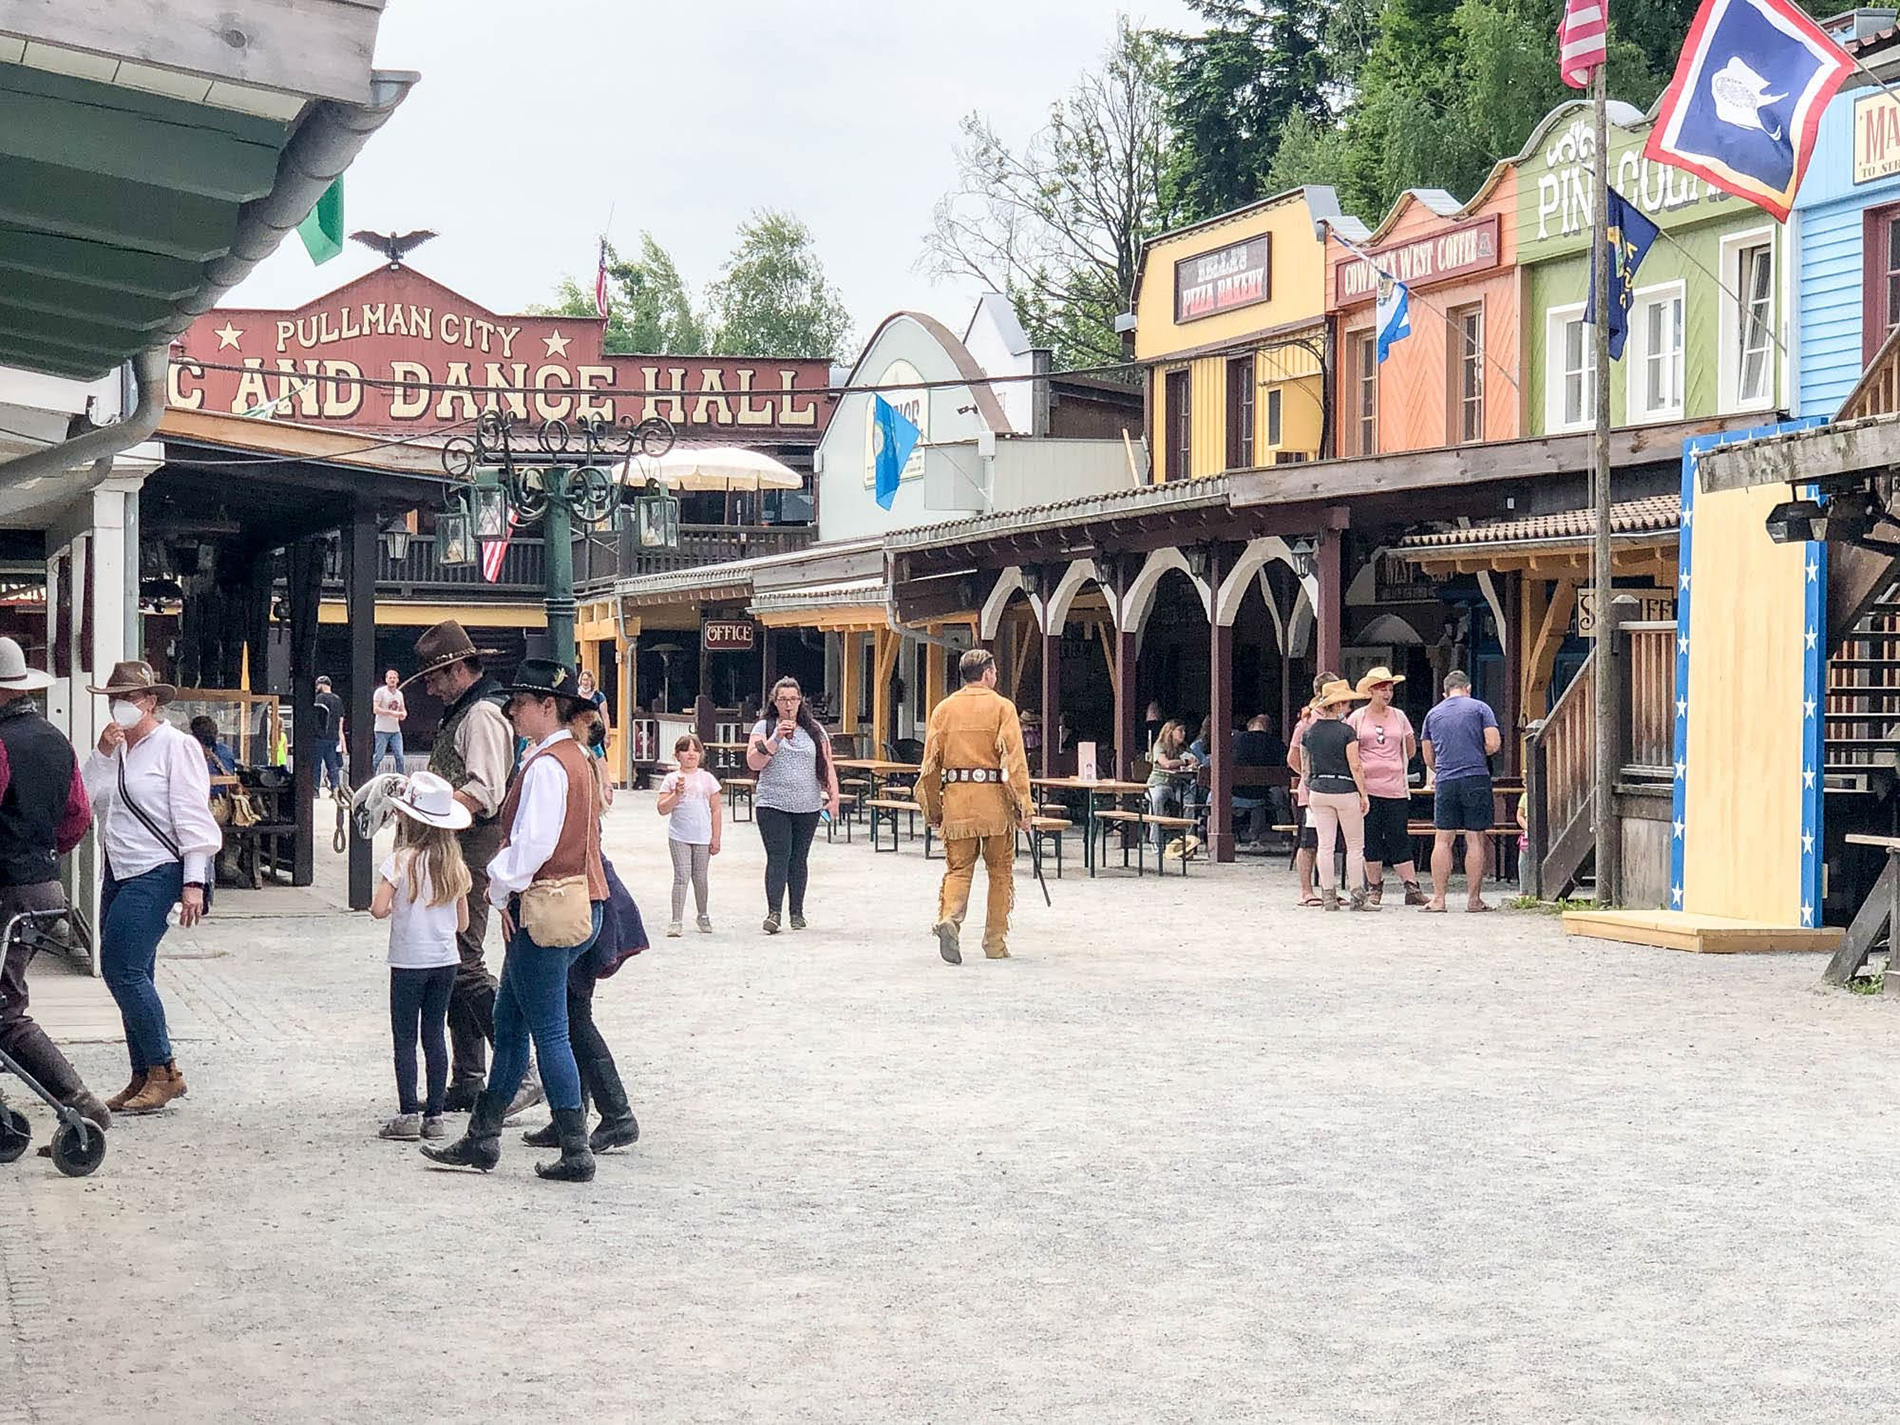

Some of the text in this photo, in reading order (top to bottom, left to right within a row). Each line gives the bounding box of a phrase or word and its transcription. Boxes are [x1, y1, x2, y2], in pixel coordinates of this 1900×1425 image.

[1538, 158, 1610, 239] PIN
[1400, 240, 1433, 281] WEST
[1437, 228, 1478, 272] COFFEE
[1182, 282, 1215, 318] PIZZA
[276, 303, 522, 359] PULLMAN CITY
[231, 357, 364, 419] AND
[389, 361, 616, 425] DANCE
[640, 367, 817, 427] HALL
[707, 625, 752, 642] OFFICE
